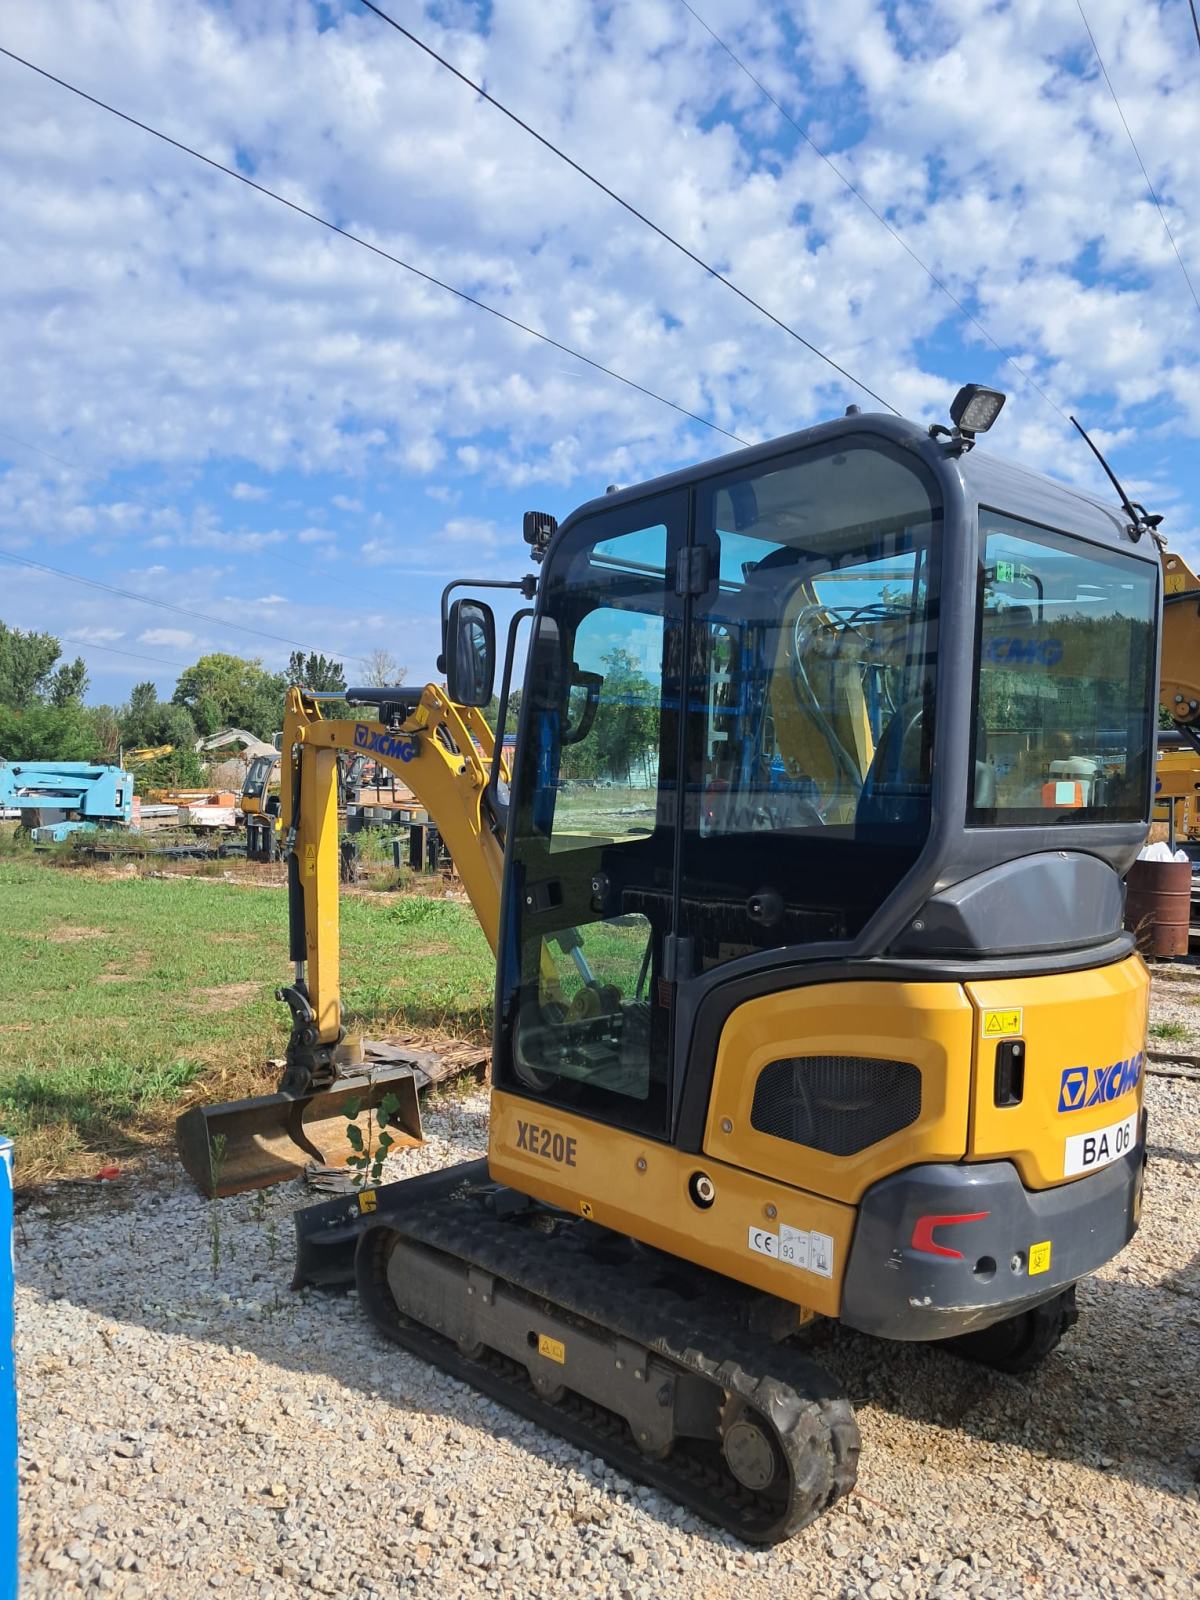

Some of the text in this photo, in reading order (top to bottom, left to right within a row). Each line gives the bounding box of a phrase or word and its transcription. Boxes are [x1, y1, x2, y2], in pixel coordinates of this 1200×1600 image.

[516, 1119, 577, 1168] XE20E
[1082, 1122, 1131, 1166] BA 06
[782, 1244, 795, 1260] 93
